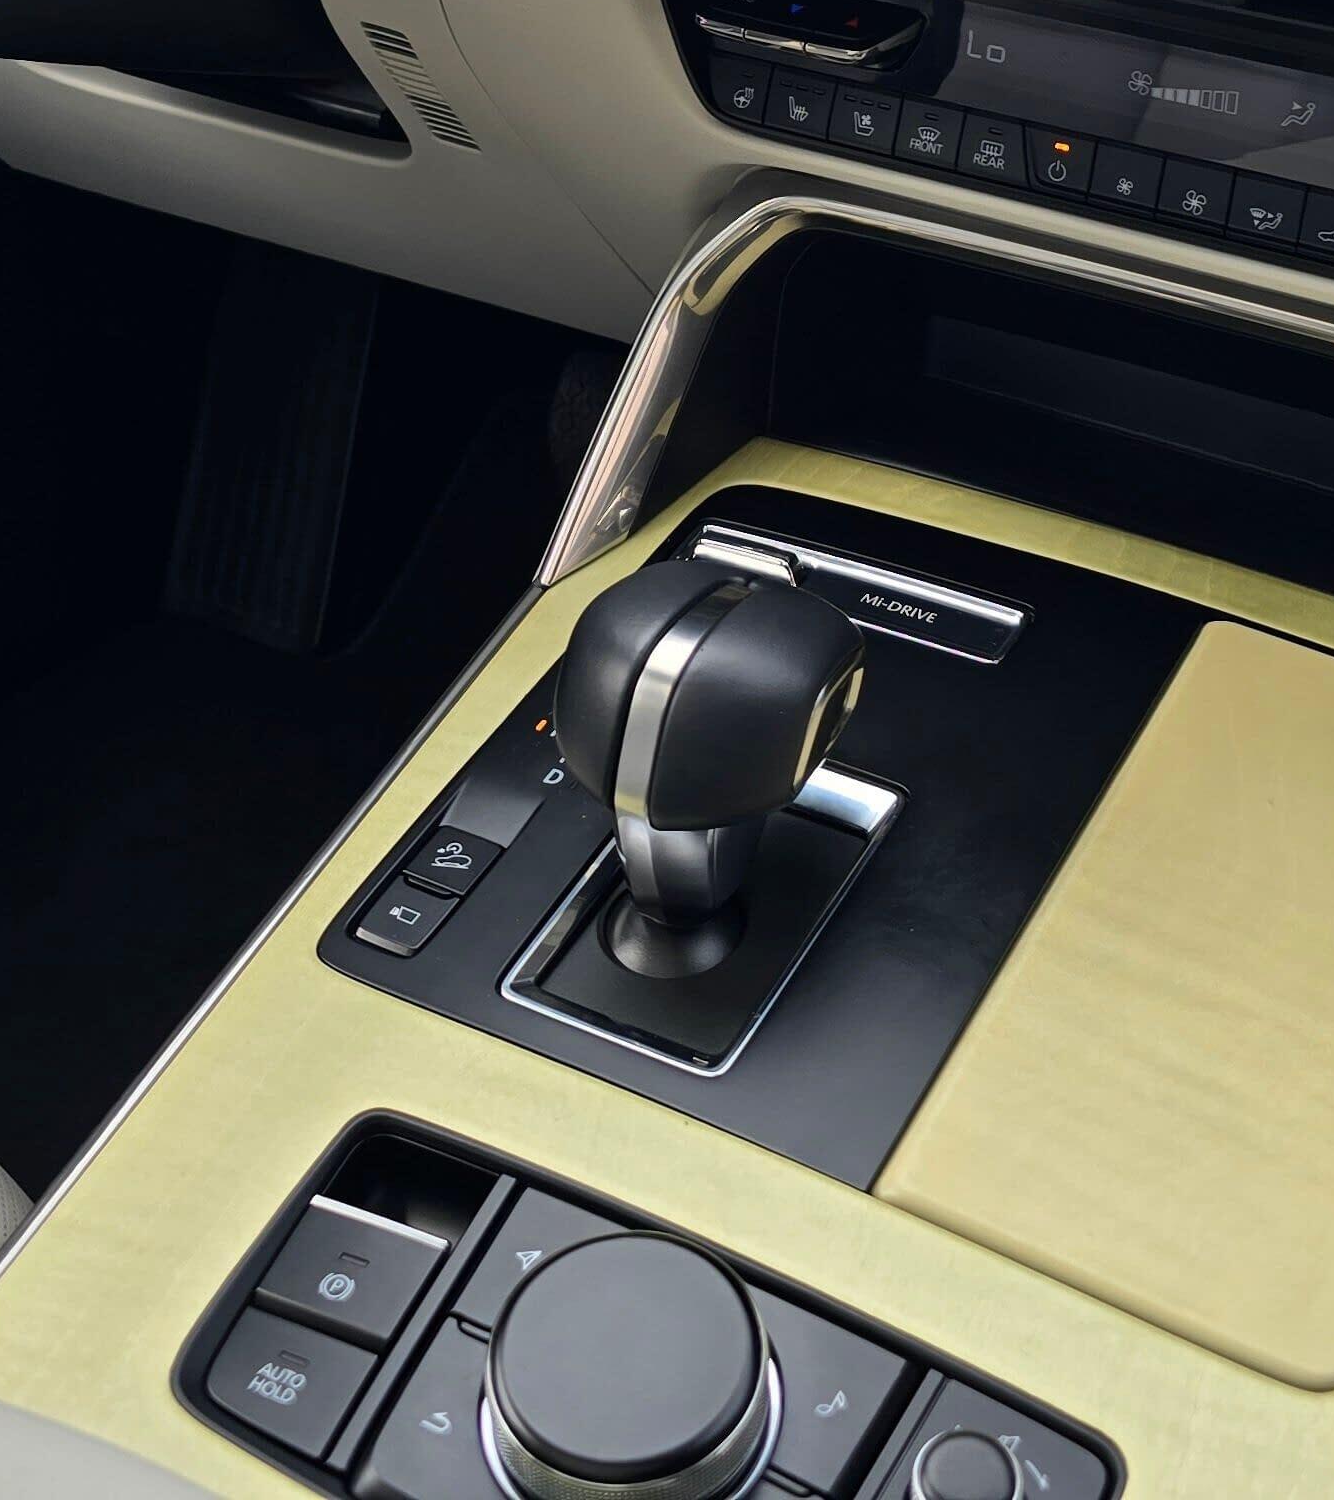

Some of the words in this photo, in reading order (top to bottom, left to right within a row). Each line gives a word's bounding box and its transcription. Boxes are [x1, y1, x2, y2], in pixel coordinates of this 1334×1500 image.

[909, 137, 944, 156] FRONT
[973, 151, 1006, 170] REAR
[543, 767, 565, 786] D
[255, 1362, 307, 1390] AUTO
[247, 1375, 297, 1405] HOLD
